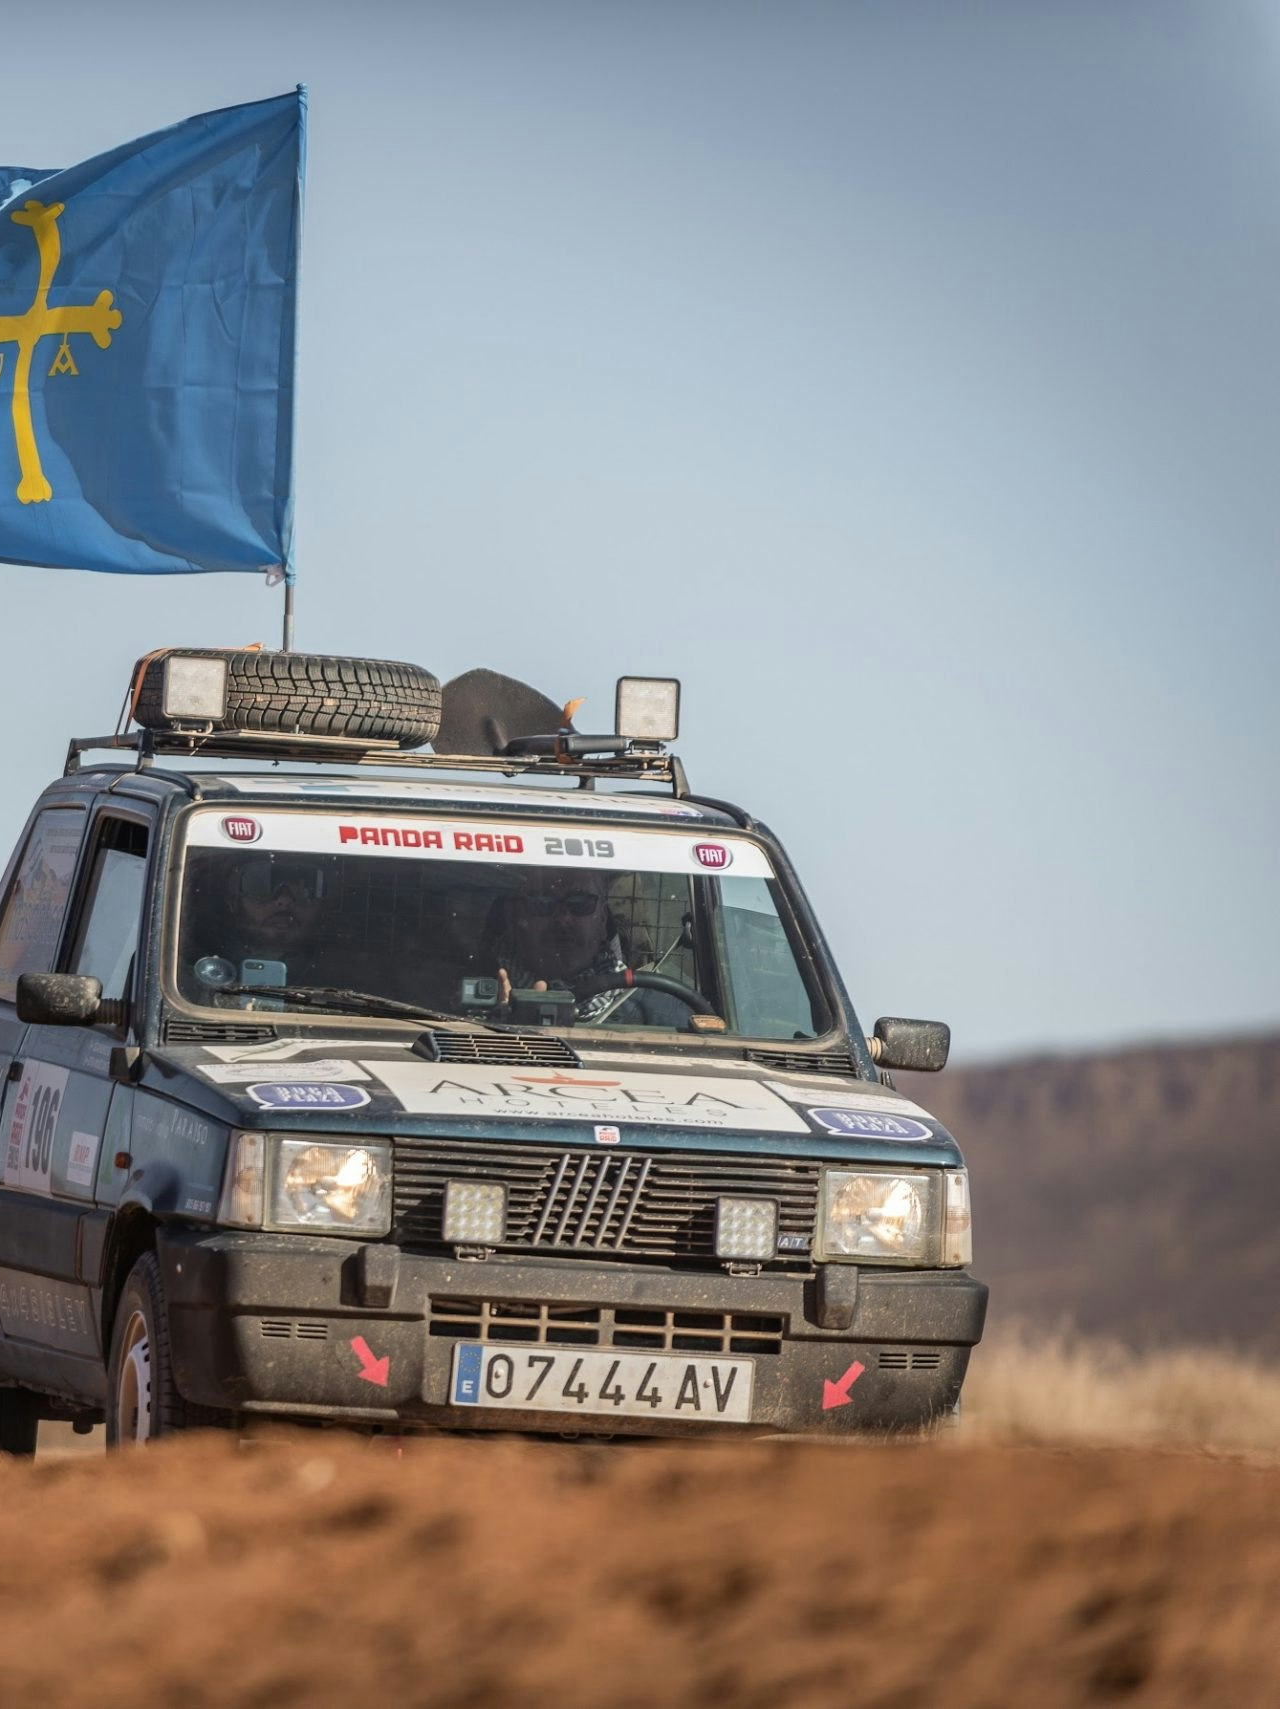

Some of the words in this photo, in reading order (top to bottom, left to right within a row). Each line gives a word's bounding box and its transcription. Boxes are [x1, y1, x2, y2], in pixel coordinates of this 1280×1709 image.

[228, 821, 253, 836] FIAT
[338, 825, 443, 849] PANDA
[543, 836, 615, 858] 2019
[699, 848, 724, 863] FIAT
[425, 1079, 748, 1110] ARCEA
[459, 1097, 728, 1118] HOTELES
[25, 1085, 60, 1175] 196
[461, 1379, 473, 1394] E
